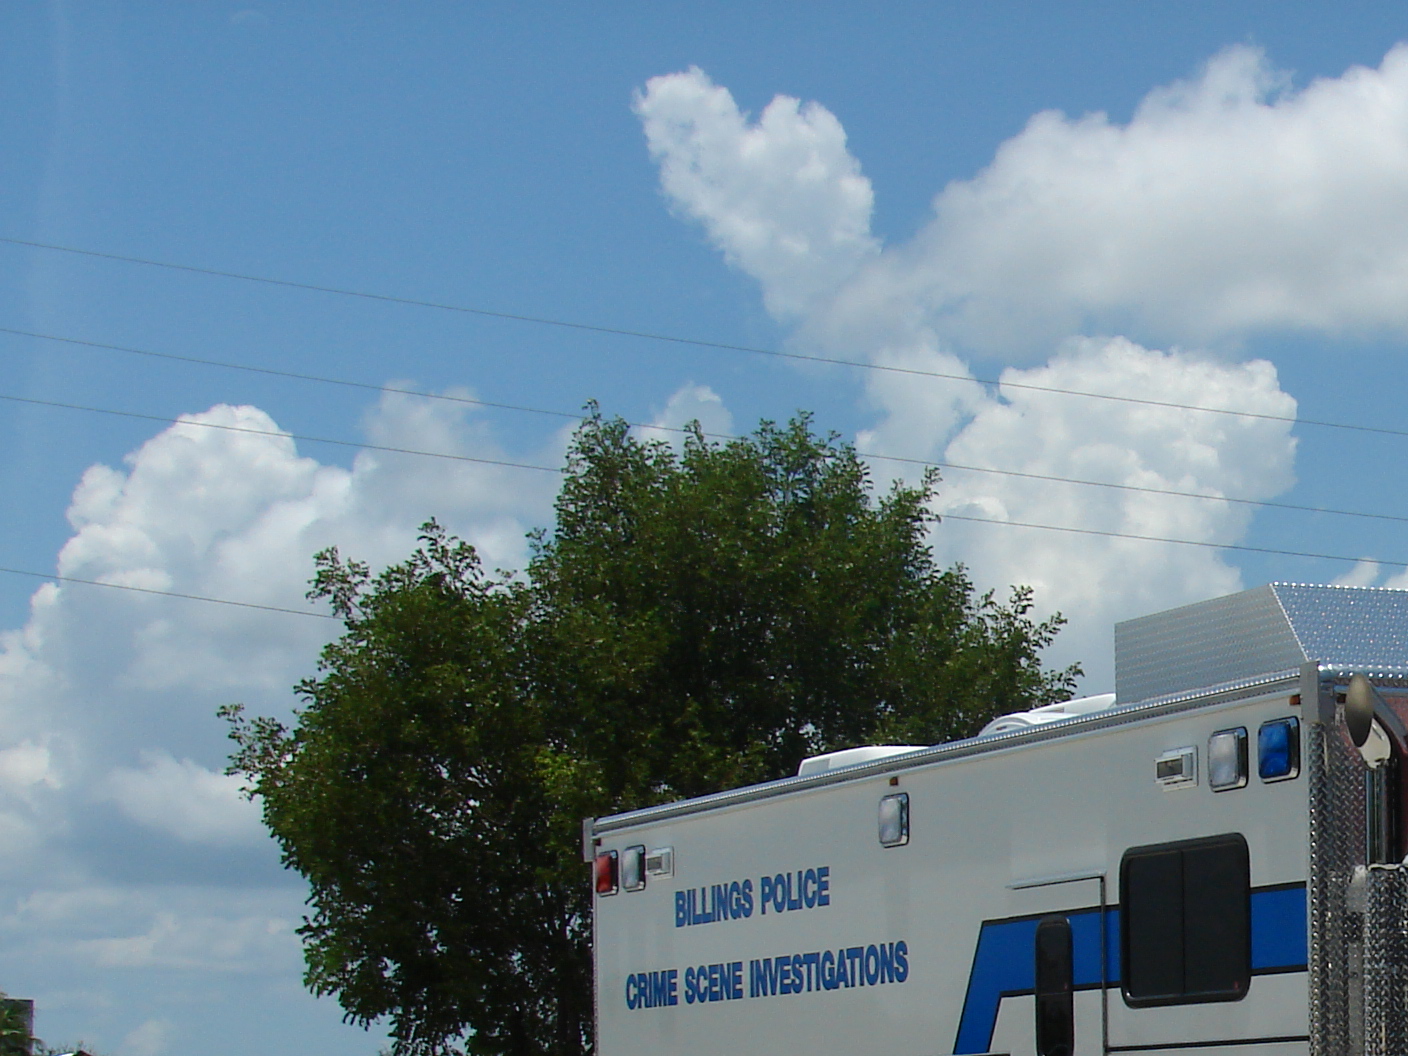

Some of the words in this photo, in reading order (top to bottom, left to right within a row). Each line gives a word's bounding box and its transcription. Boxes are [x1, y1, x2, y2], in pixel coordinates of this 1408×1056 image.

[675, 879, 754, 928] BILLINGS
[761, 866, 830, 915] POLICE
[625, 968, 678, 1010] CRIME
[684, 961, 743, 1004] SCENE
[750, 940, 909, 998] INVESTIGATIONS
